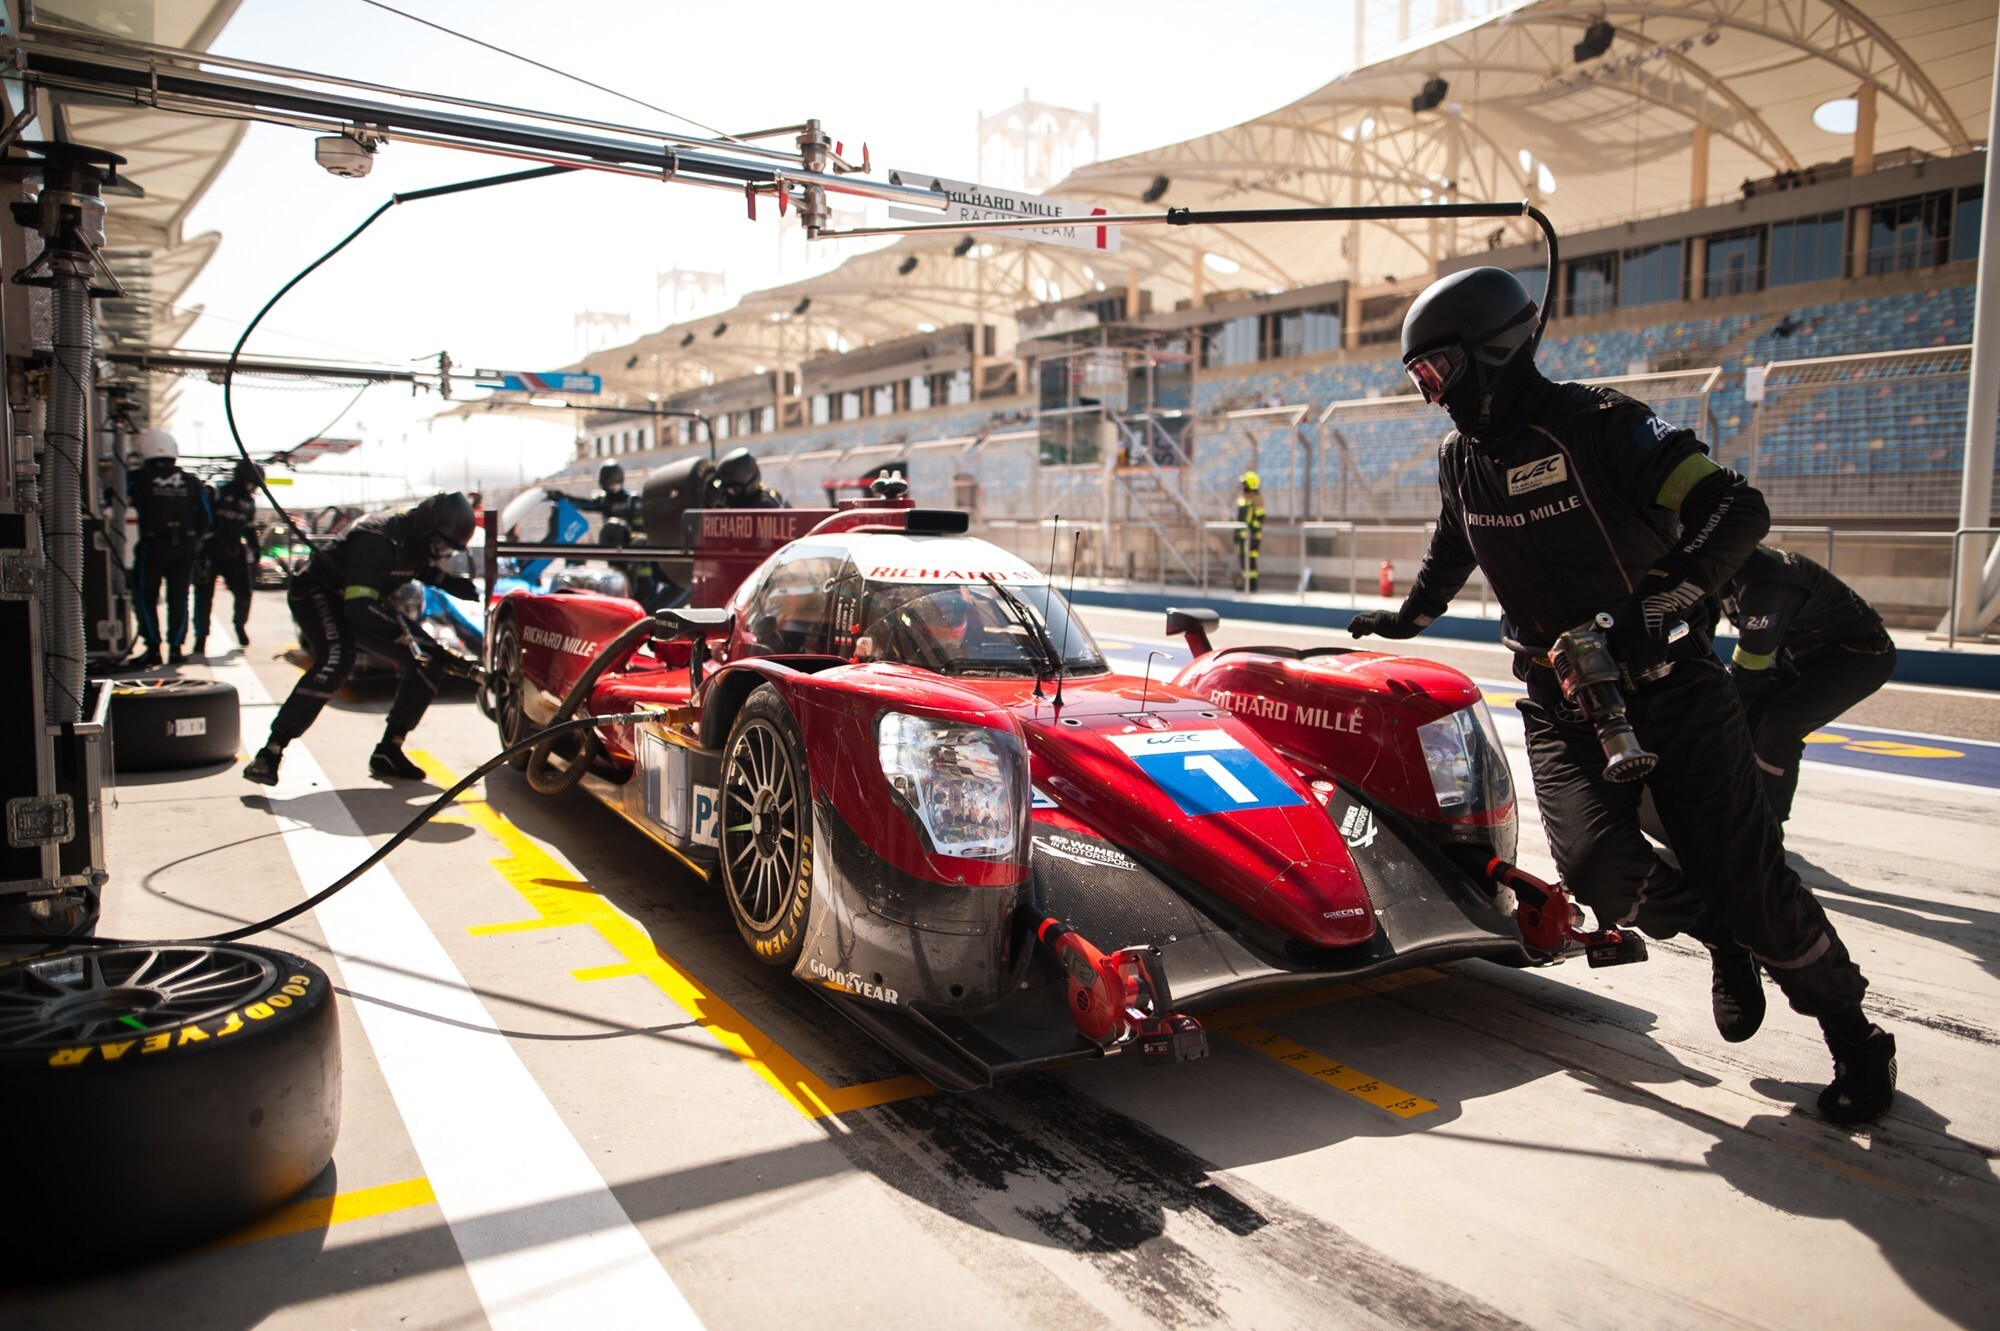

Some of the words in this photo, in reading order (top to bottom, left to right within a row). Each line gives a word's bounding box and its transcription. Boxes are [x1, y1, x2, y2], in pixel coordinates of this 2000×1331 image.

[1020, 200, 1063, 217] MILLE
[1511, 456, 1560, 483] WEC
[1468, 513, 1526, 527] RICHARD
[1529, 495, 1581, 521] MILLE
[703, 516, 751, 538] RICHARD
[757, 517, 797, 540] MILLE
[869, 566, 1007, 581] RICHARD
[523, 626, 562, 649] RICHARD
[563, 635, 598, 657] MILLE
[1210, 689, 1288, 721] RICHARD
[1295, 704, 1364, 734] MILLE
[1146, 733, 1201, 745] WEC
[1184, 754, 1259, 803] 1
[1061, 844, 1137, 869] MOTORSPORT
[1070, 840, 1125, 860] WOMEN
[755, 834, 814, 956] GOODYEAR
[810, 958, 899, 1005] GOODYEAR
[48, 974, 311, 1066] GOODYEAR
